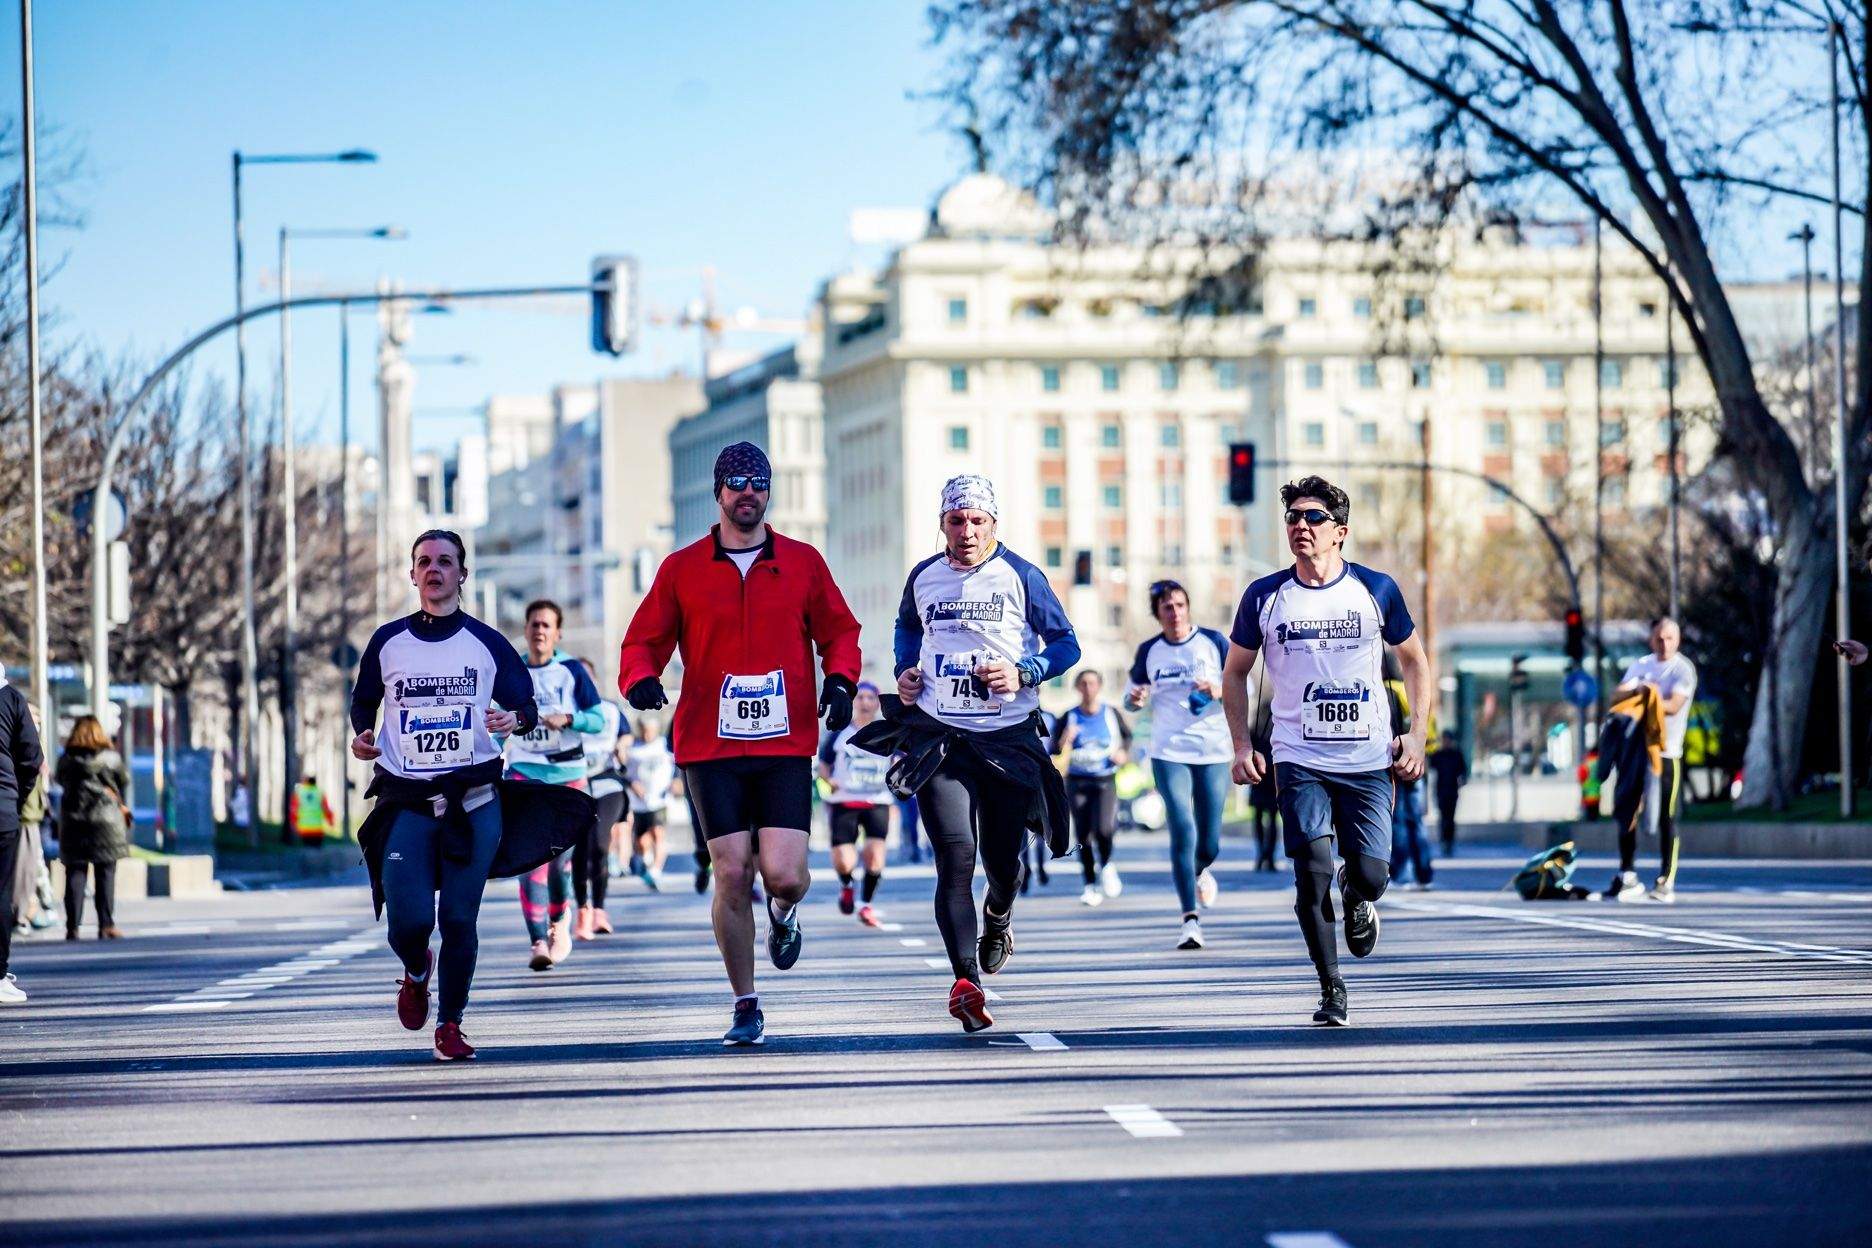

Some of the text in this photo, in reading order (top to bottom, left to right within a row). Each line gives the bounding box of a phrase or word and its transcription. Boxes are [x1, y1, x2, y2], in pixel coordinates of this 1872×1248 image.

[941, 602, 1001, 611] BOMBEROS
[972, 611, 1000, 620] MADRID
[1294, 620, 1358, 630] BOMBEROS
[1319, 628, 1359, 638] de MADRID
[410, 678, 474, 687] BOMBEROS
[447, 686, 474, 695] MADRID
[742, 683, 772, 692] BOMBOS
[951, 679, 980, 698] 74
[738, 698, 770, 720] 693
[1316, 702, 1360, 722] 1688
[420, 716, 460, 724] BOMBEROS
[414, 730, 460, 753] 1226
